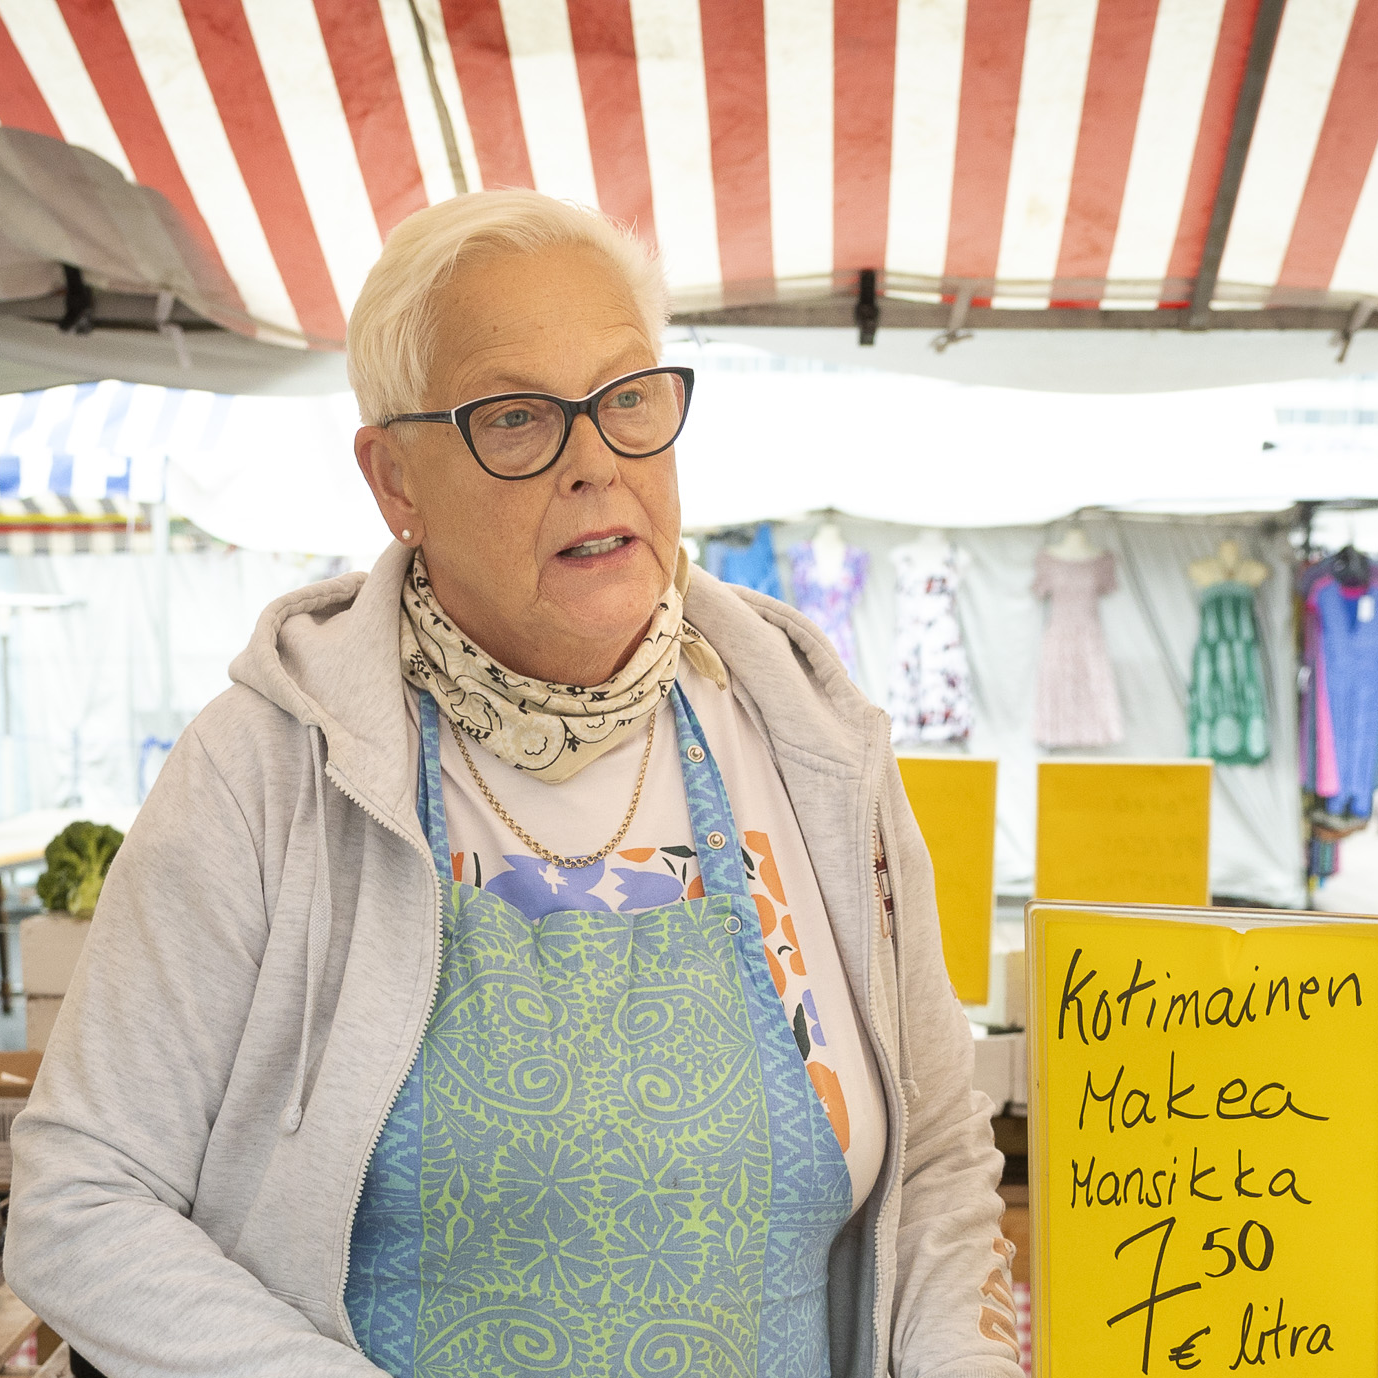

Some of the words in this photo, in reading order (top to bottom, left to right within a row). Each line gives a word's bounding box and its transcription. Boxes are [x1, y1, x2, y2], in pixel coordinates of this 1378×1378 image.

[1058, 948, 1363, 1045] Kotimainen
[1079, 1051, 1330, 1132] Makea
[1070, 1147, 1312, 1209] Mansikka
[1168, 1326, 1210, 1370] €
[1229, 1298, 1334, 1370] litra
